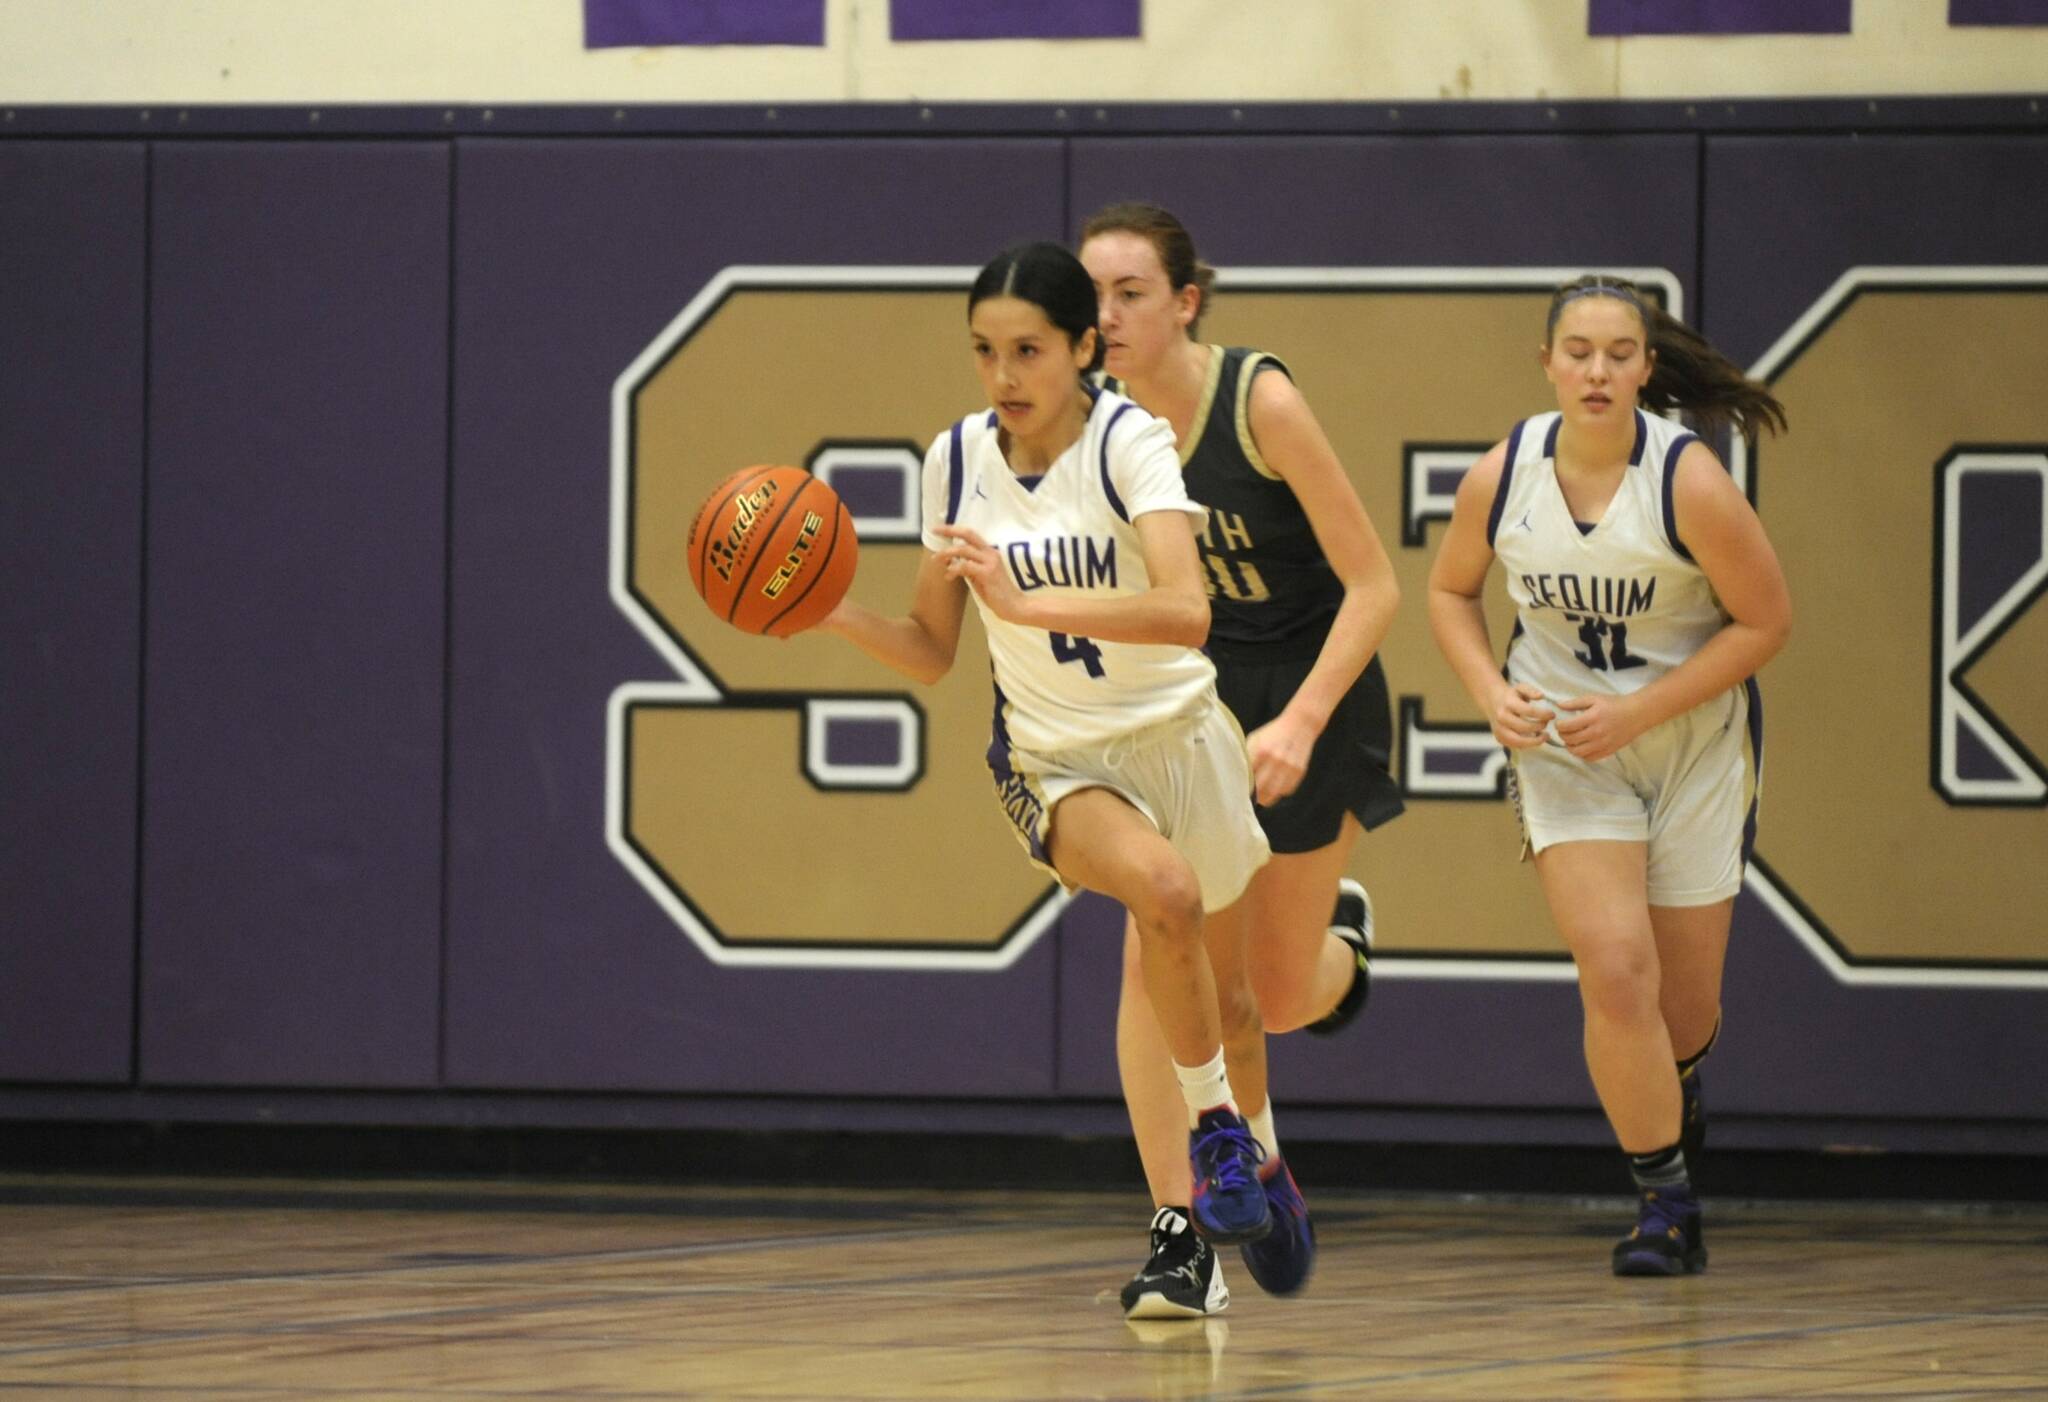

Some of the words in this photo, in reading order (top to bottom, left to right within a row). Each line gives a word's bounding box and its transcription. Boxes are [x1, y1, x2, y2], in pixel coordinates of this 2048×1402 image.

[708, 479, 779, 583] Baden
[761, 510, 823, 600] ELITE
[992, 536, 1118, 592] QUIM
[1521, 573, 1657, 617] SEQUIM
[1049, 630, 1106, 679] 4
